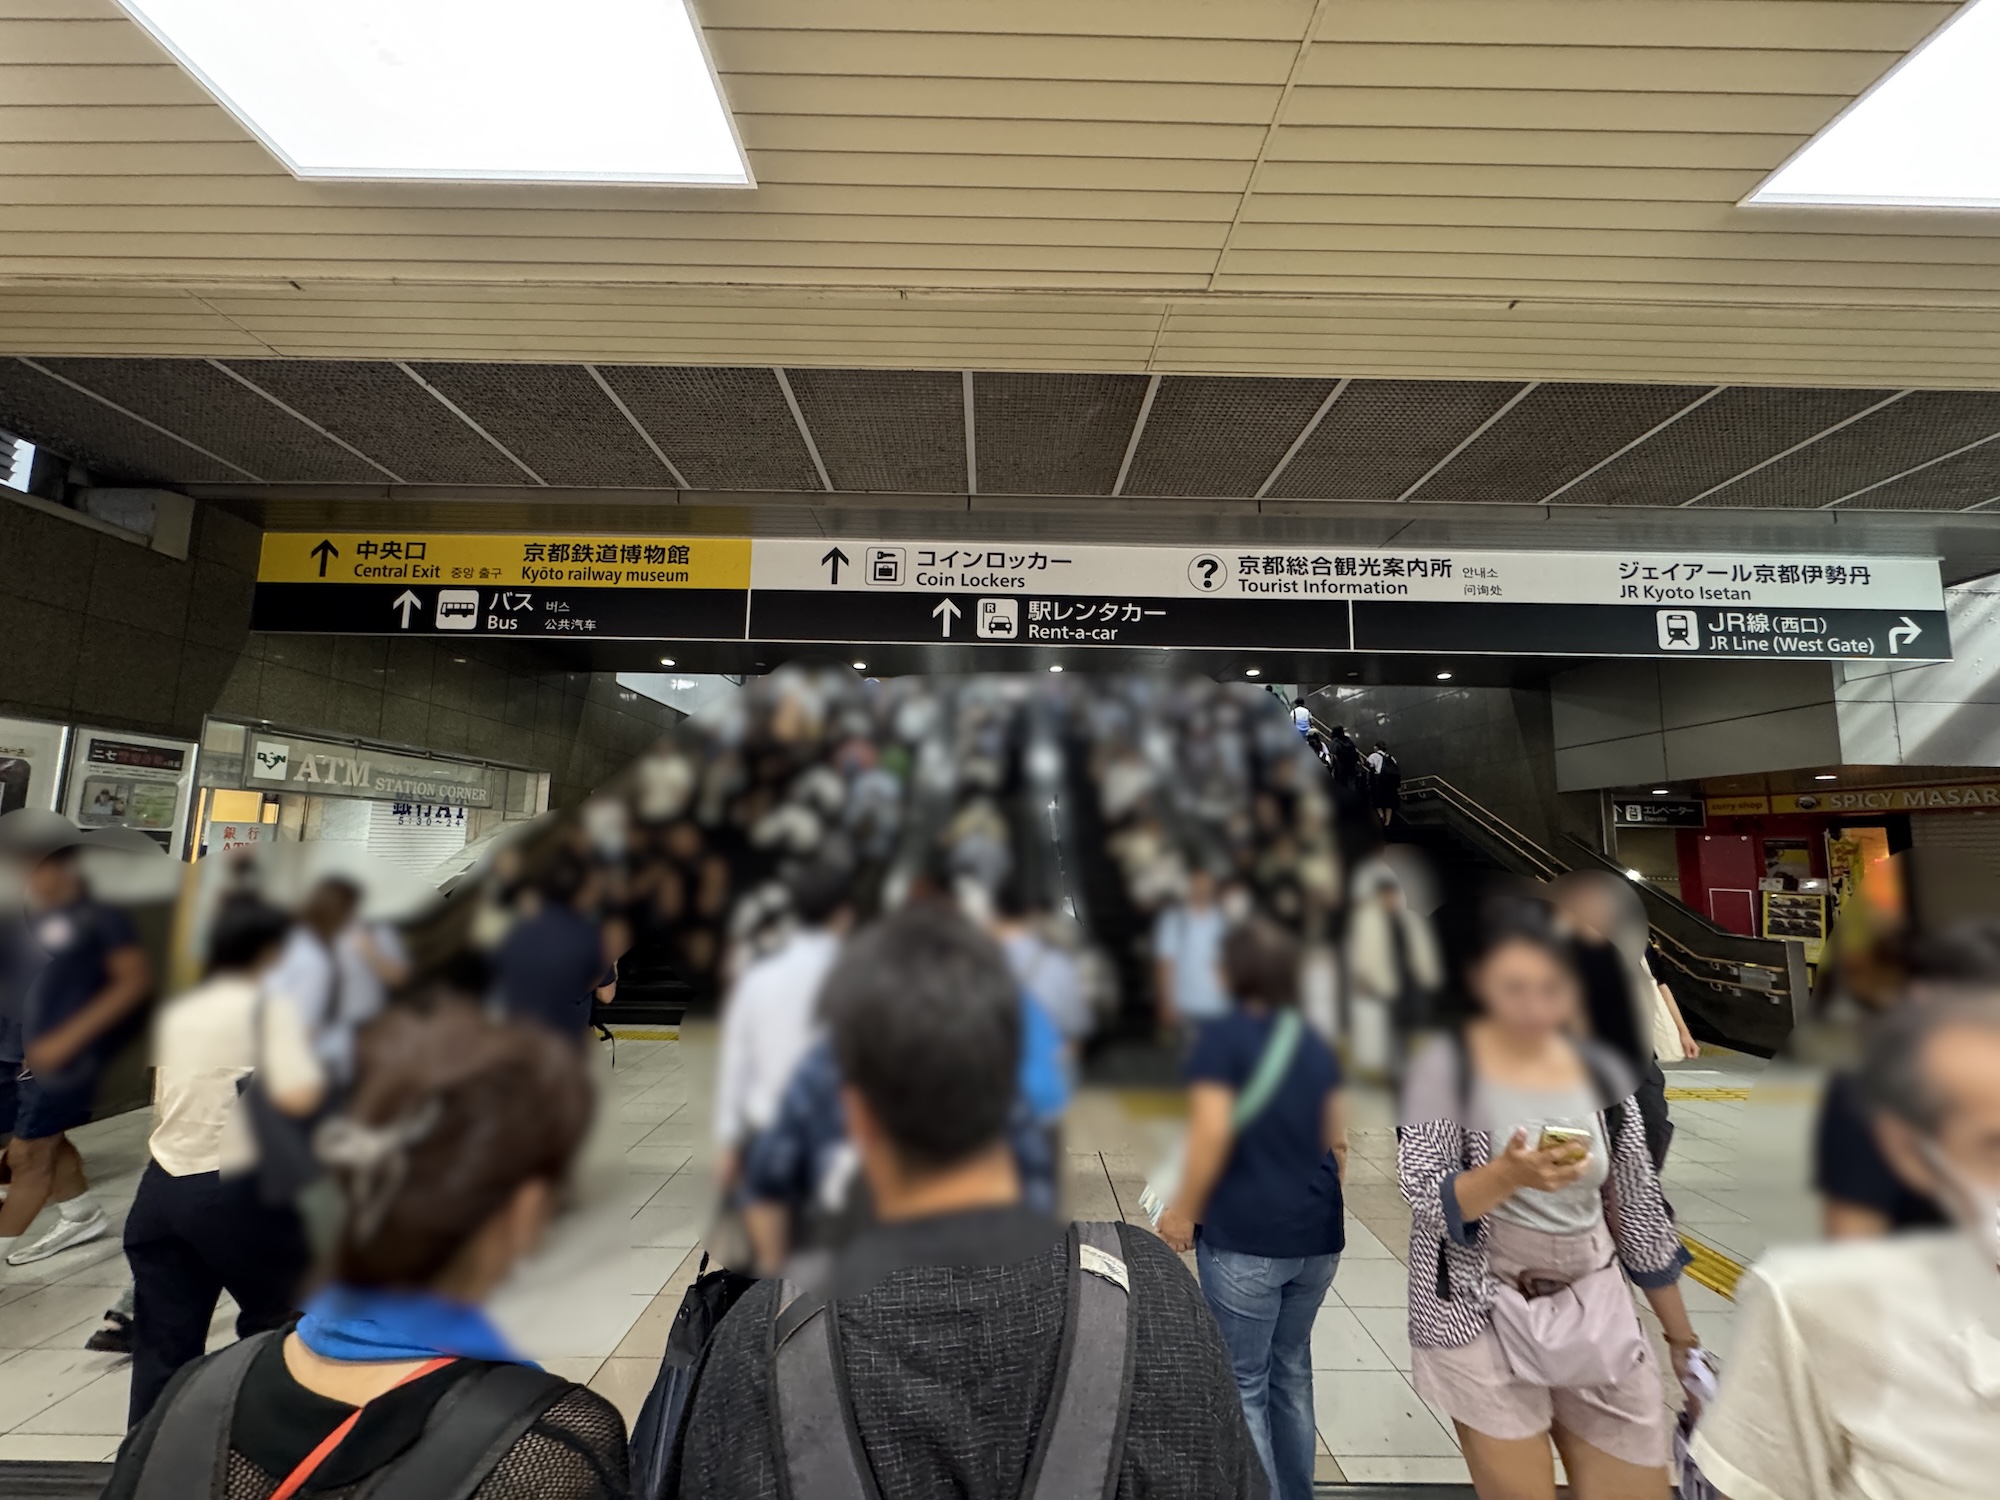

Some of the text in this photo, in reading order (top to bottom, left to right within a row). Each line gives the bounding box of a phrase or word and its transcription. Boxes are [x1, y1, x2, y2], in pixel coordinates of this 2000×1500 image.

[357, 540, 426, 560] 中央口
[523, 543, 690, 564] 京都鉄道博物館
[917, 550, 1072, 570] コインロッカー
[1238, 555, 1452, 578] 京都総合観光案内所
[354, 564, 440, 578] Central Exit
[451, 567, 502, 579] 중앙 출구
[522, 566, 689, 584] Kyōto railway museum
[1462, 567, 1499, 579] 안내소
[1619, 561, 1871, 585] ジェイアール京都伊勢丹
[916, 573, 1025, 588] Coin Lockers
[1238, 579, 1408, 595] Tourist Information
[1463, 584, 1503, 596] 问询处
[1620, 585, 1751, 602] JR Kyoto Isetan
[489, 591, 534, 611] バス
[545, 601, 570, 613] 버스
[1028, 601, 1167, 622] 駅レンタカー
[487, 615, 518, 630] Bus
[544, 619, 597, 631] 公共汽车
[1028, 624, 1118, 640] Rent-a-car
[1709, 636, 1874, 655] JR Line (West Gate)
[294, 753, 371, 788] ATM
[375, 777, 436, 796] STATION
[439, 785, 487, 801] CORNER
[1711, 801, 1763, 811] curry shop
[1831, 792, 1895, 809] SPICY
[1643, 806, 1695, 815] エレベーター
